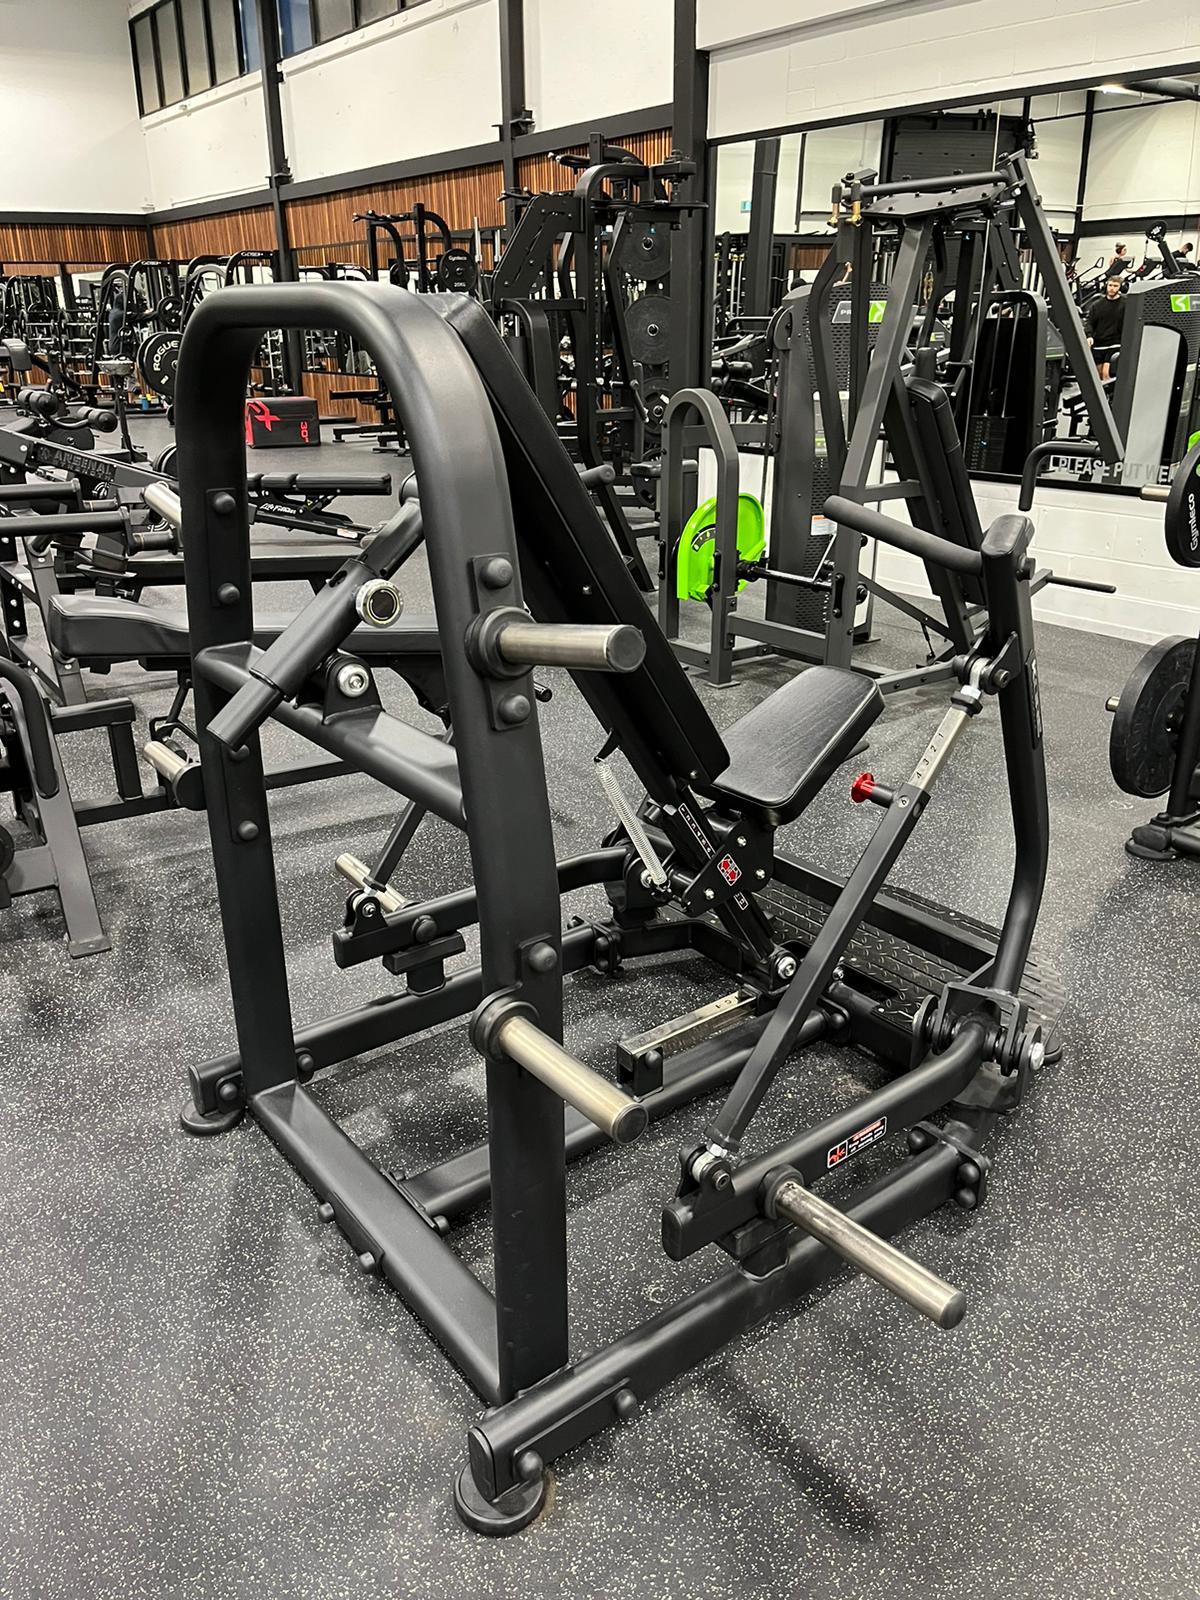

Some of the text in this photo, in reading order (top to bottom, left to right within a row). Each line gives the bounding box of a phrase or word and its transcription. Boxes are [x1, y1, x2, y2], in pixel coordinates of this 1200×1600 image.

[153, 340, 180, 371] ROGUE
[54, 450, 112, 475] ARSENAL
[1059, 457, 1110, 477] PLEASE
[1113, 461, 1143, 480] PUT
